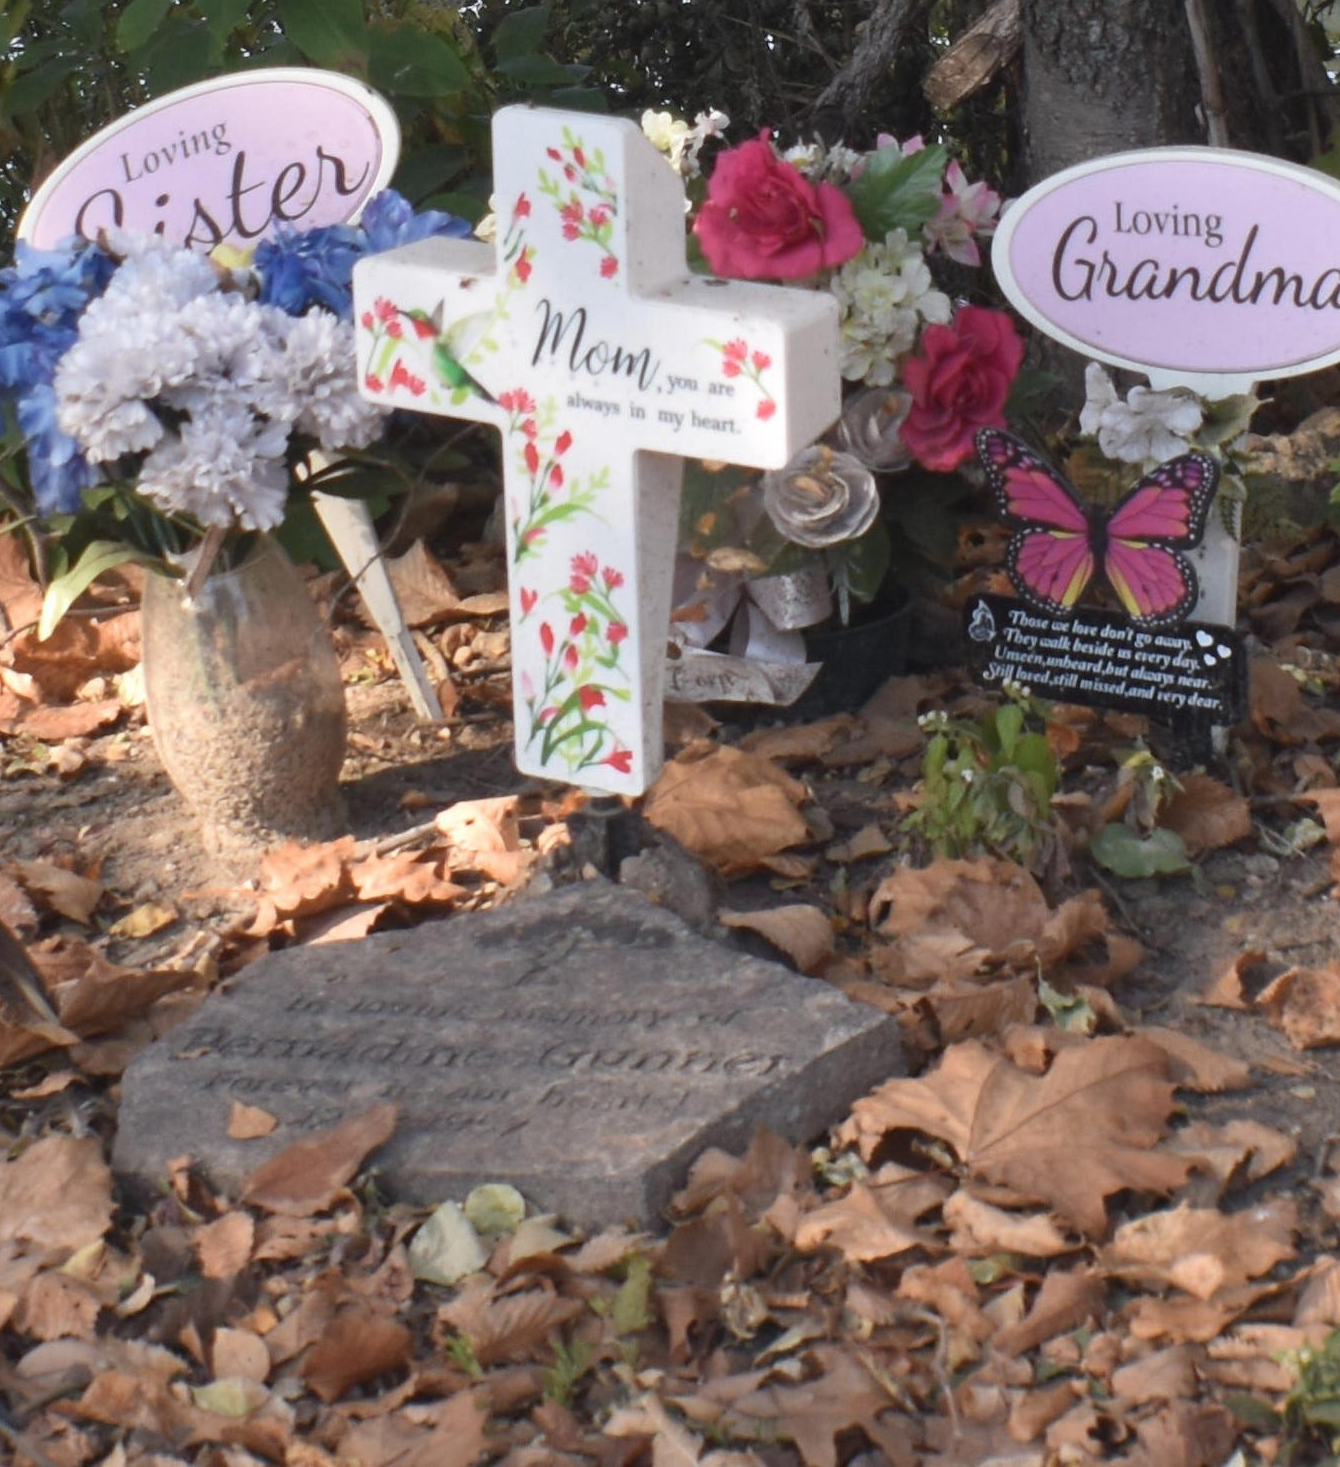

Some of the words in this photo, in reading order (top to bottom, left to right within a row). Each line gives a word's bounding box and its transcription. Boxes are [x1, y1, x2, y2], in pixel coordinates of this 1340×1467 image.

[120, 120, 233, 183] Loving
[1114, 200, 1224, 247] Loving
[666, 374, 698, 394] you
[708, 383, 735, 397] are
[566, 393, 620, 415] always
[629, 401, 646, 420] in
[658, 410, 685, 431] my
[691, 411, 741, 433] heart.
[1003, 627, 1039, 649] They
[1040, 635, 1071, 651] walk
[1073, 637, 1114, 657] beside
[1117, 648, 1132, 660] us
[1134, 650, 1171, 668] every
[1171, 652, 1201, 671] day.
[1009, 609, 1049, 630] Those
[1051, 619, 1068, 632] we
[1072, 619, 1098, 636] love
[1100, 623, 1134, 641] don't
[1134, 632, 1152, 648] go
[1155, 635, 1192, 651] away.
[982, 662, 1014, 683] Still
[1157, 693, 1186, 709] very
[1188, 690, 1224, 711] dear.
[1130, 663, 1174, 685] always
[1177, 675, 1212, 690] near.
